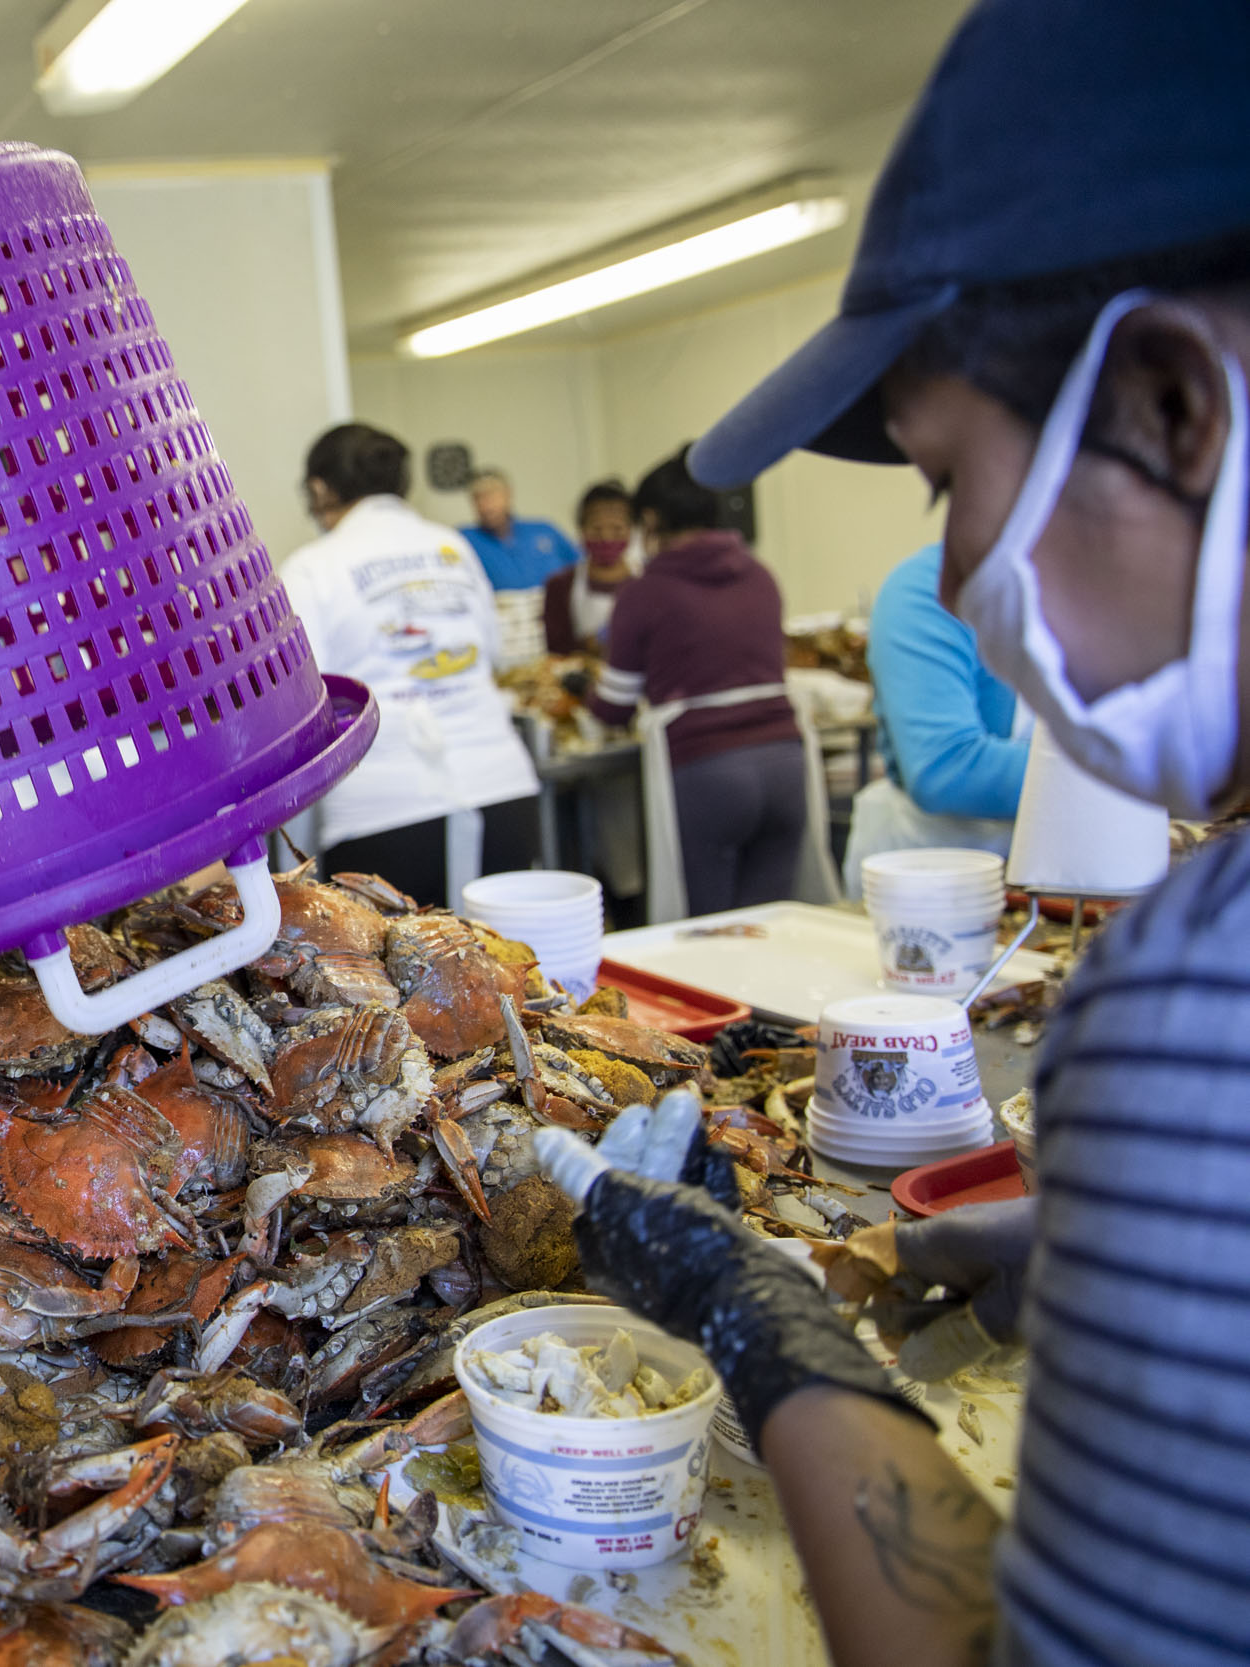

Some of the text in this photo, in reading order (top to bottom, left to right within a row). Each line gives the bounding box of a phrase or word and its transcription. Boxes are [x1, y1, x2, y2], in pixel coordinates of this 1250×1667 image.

[830, 1031, 876, 1049] MEAT
[883, 1035, 938, 1052] CRAB
[898, 1078, 937, 1114] OLD
[557, 1446, 588, 1456] KEEP
[592, 1447, 623, 1457] WELL
[595, 1537, 613, 1545] NET
